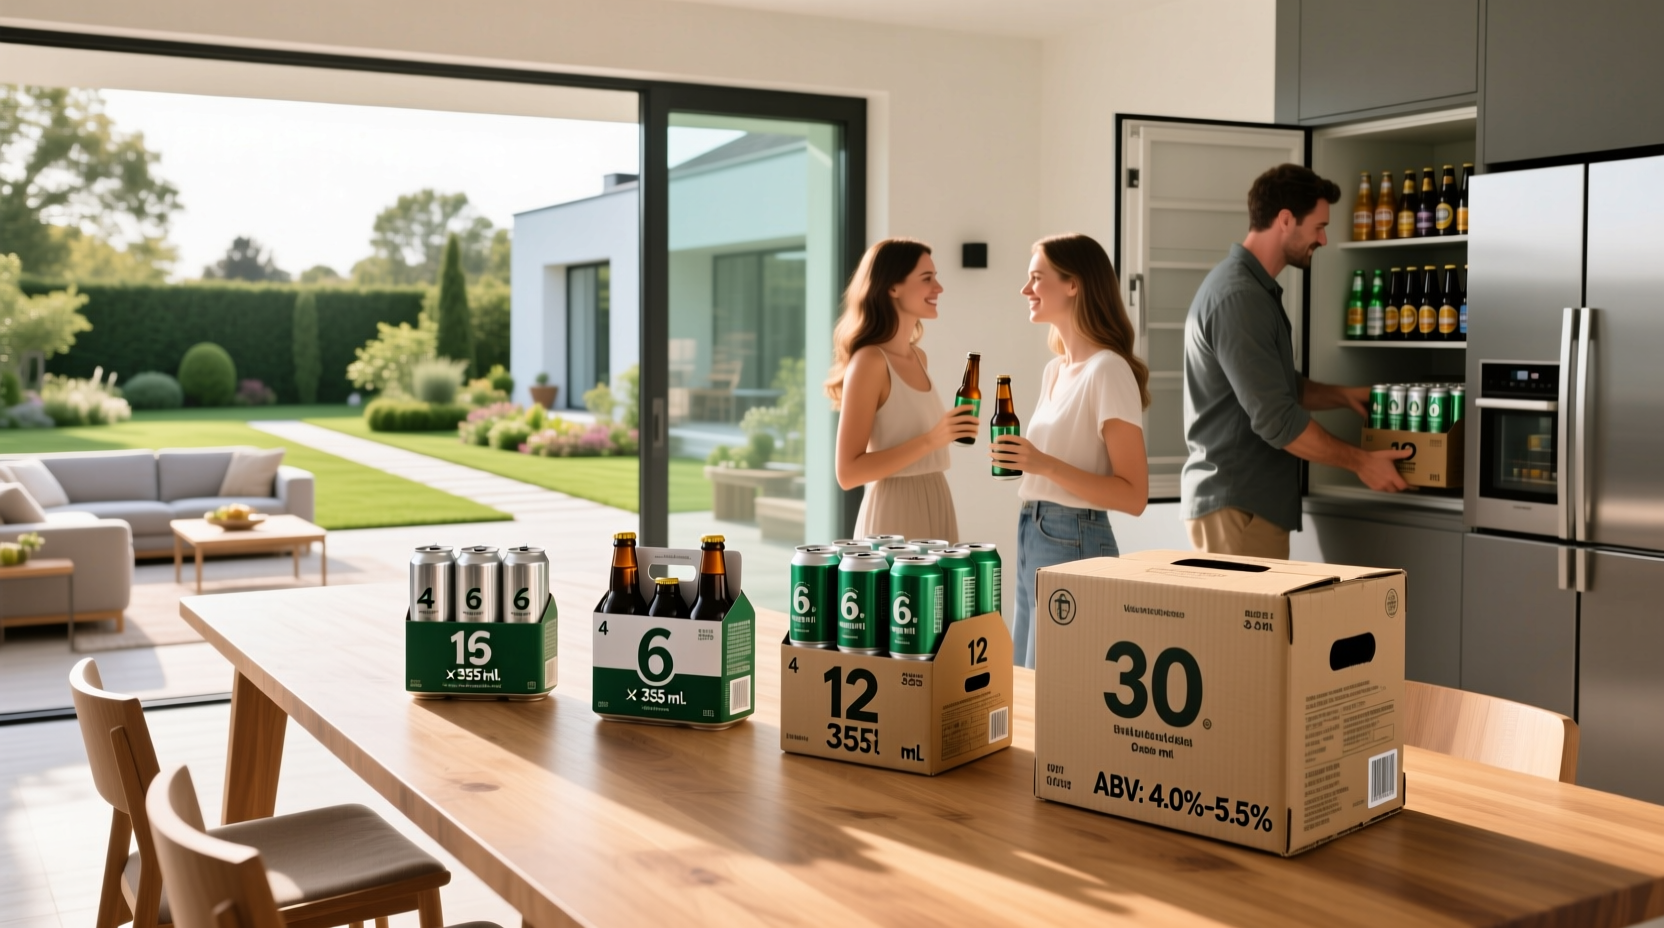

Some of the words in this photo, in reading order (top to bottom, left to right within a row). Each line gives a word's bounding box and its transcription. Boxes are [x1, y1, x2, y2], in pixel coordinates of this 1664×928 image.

[417, 587, 435, 609] 4
[465, 587, 482, 610] 6
[513, 587, 530, 610] 6
[598, 620, 609, 635] 4
[638, 627, 673, 682] 6
[968, 636, 988, 666] 12
[788, 656, 799, 673] 4
[823, 665, 879, 724] 12
[1103, 640, 1203, 728] 30
[641, 688, 665, 704] 355
[901, 744, 924, 762] mL
[1093, 771, 1144, 804] ABV:
[1149, 783, 1273, 833] 4.0%-5.5%
